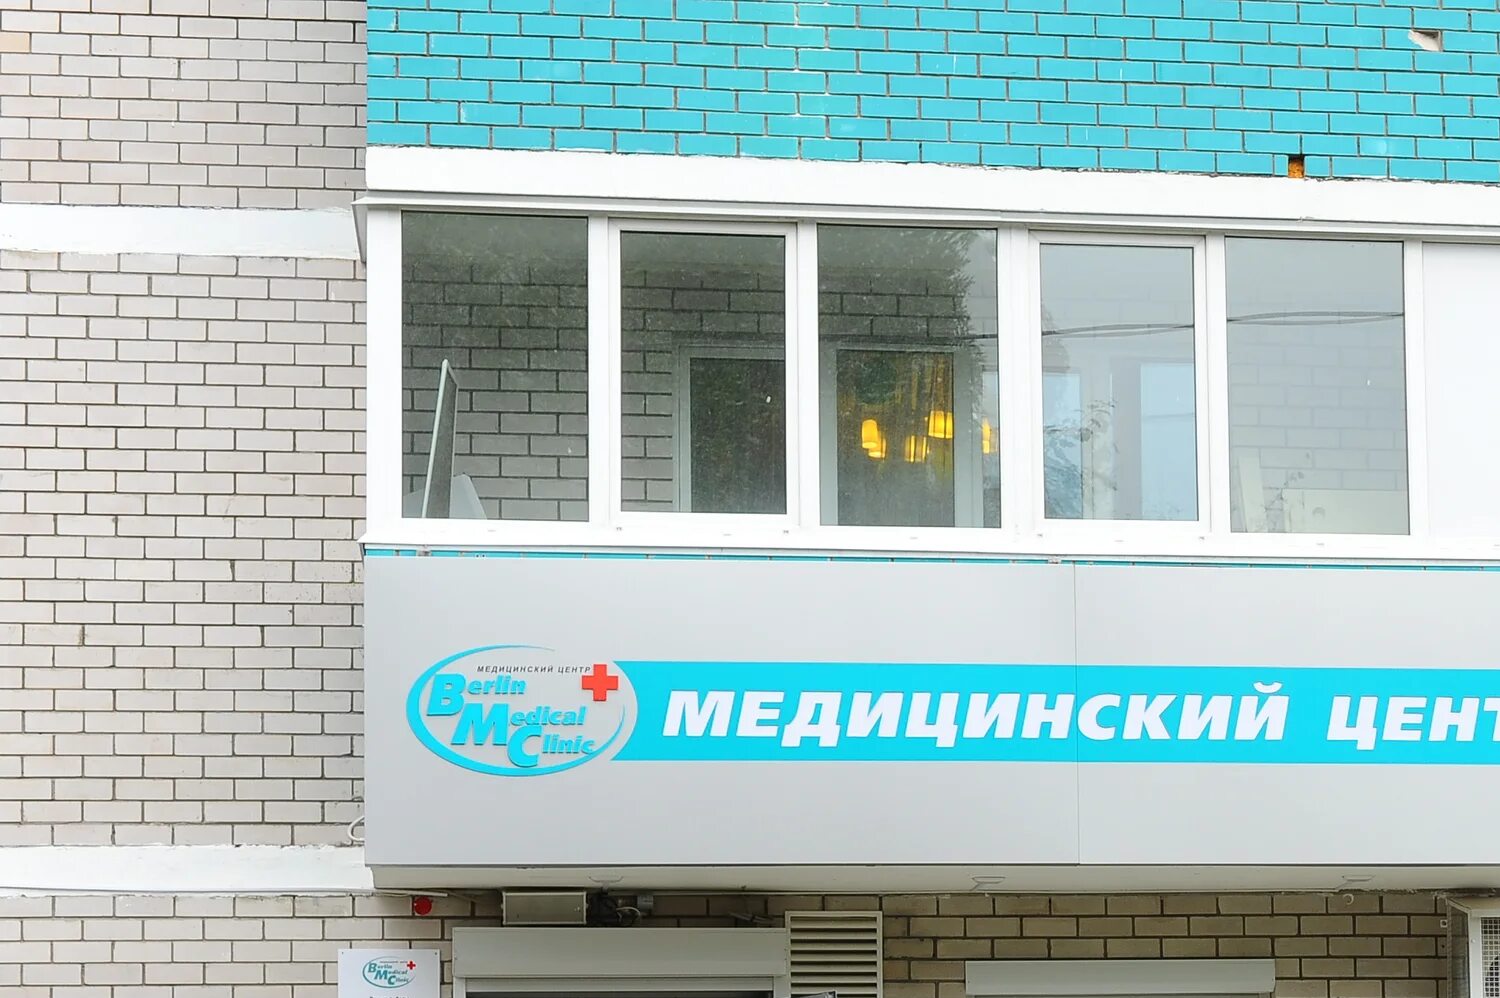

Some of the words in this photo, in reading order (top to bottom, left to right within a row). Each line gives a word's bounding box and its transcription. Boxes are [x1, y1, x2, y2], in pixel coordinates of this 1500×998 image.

[477, 665, 554, 673] МЕДИЦИНСКИЙ
[557, 666, 592, 674] ЦЕНТР
[427, 673, 527, 716] Berlin
[662, 680, 1290, 748] МЕДИЦИНСКИЙ
[451, 703, 587, 745] Medical
[507, 725, 596, 767] Clinic
